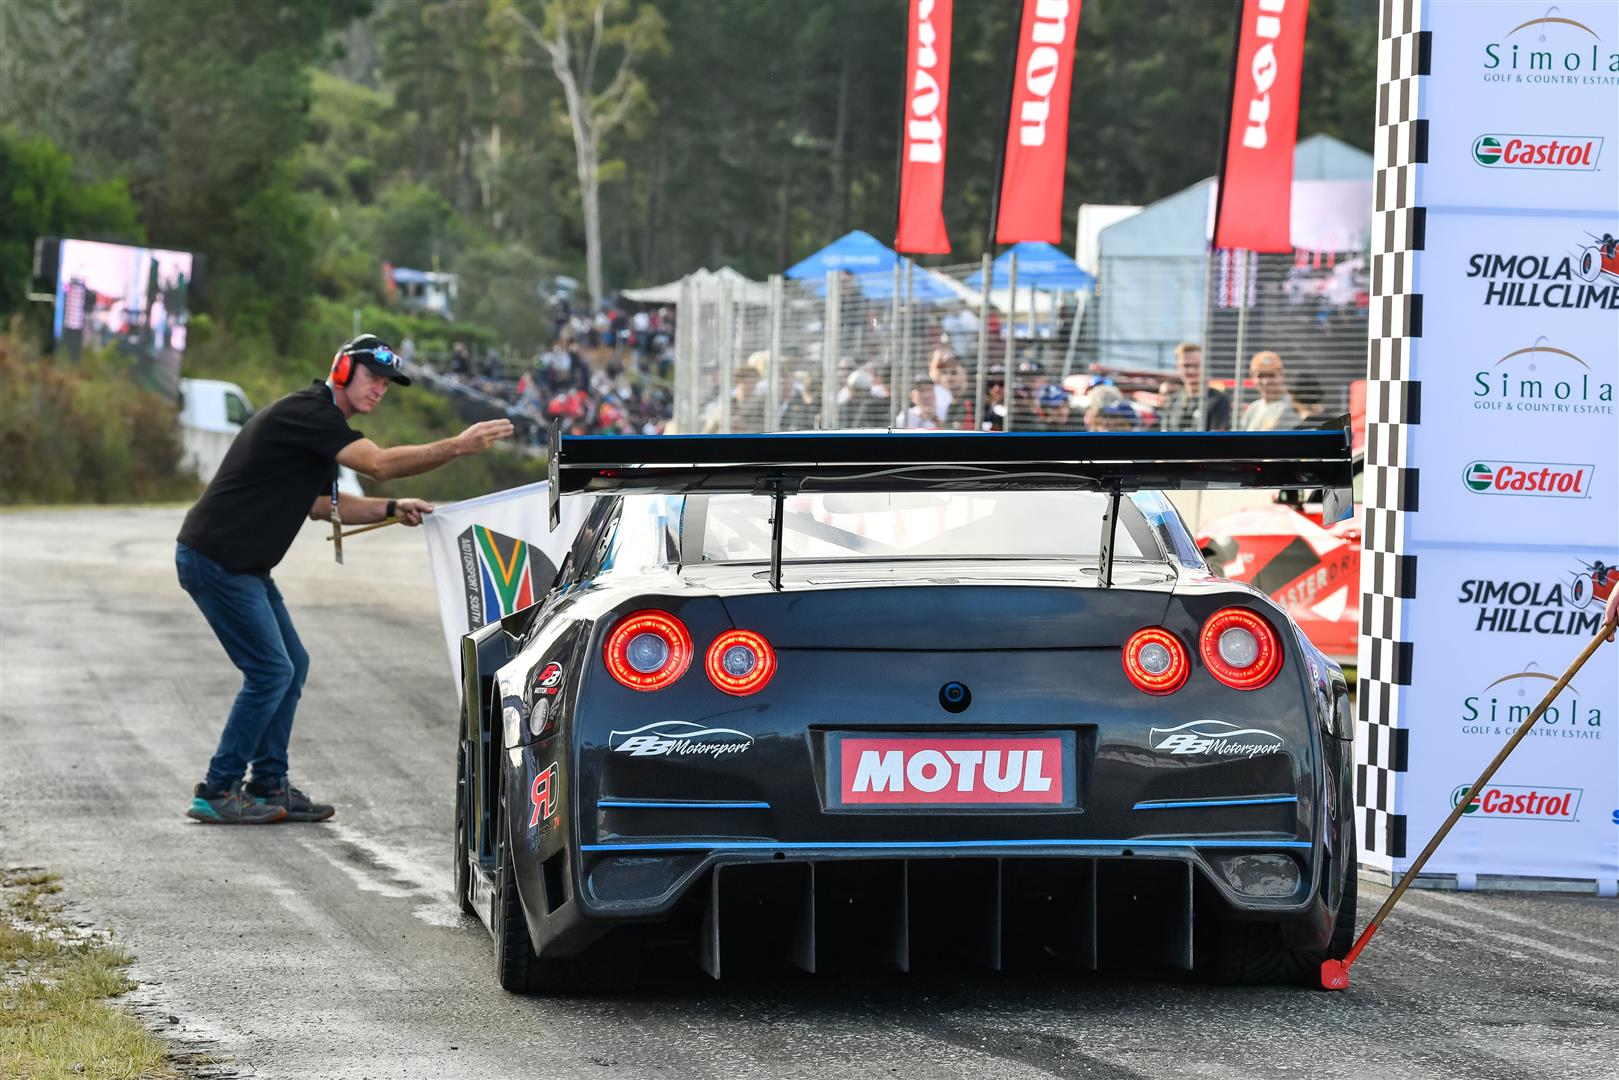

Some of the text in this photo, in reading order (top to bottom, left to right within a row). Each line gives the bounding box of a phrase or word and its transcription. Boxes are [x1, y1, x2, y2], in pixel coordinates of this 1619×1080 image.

[1484, 43, 1619, 72] Simola
[1483, 73, 1511, 83] GOLF
[1515, 74, 1523, 83] &
[1526, 74, 1579, 84] COUNTRY
[1503, 139, 1592, 165] Castrol
[1466, 253, 1573, 281] SIMOLA
[1474, 371, 1613, 401] Simola
[1473, 400, 1613, 415] GOLF & COUNTRY ESTATE
[1495, 465, 1583, 493] Castrol
[461, 537, 480, 624] MOTORSPORT SOUTH
[1458, 579, 1564, 605] SIMOLA
[1475, 607, 1603, 636] HILLCLIM
[1462, 696, 1602, 726] Simola
[1462, 725, 1491, 735] GOLF
[1494, 726, 1501, 736] &
[1561, 729, 1602, 740] ESTATE
[665, 738, 752, 760] Motorsport
[1203, 736, 1283, 761] Motorsport
[851, 749, 1053, 793] MOTUL
[1482, 789, 1571, 816] Castrol
